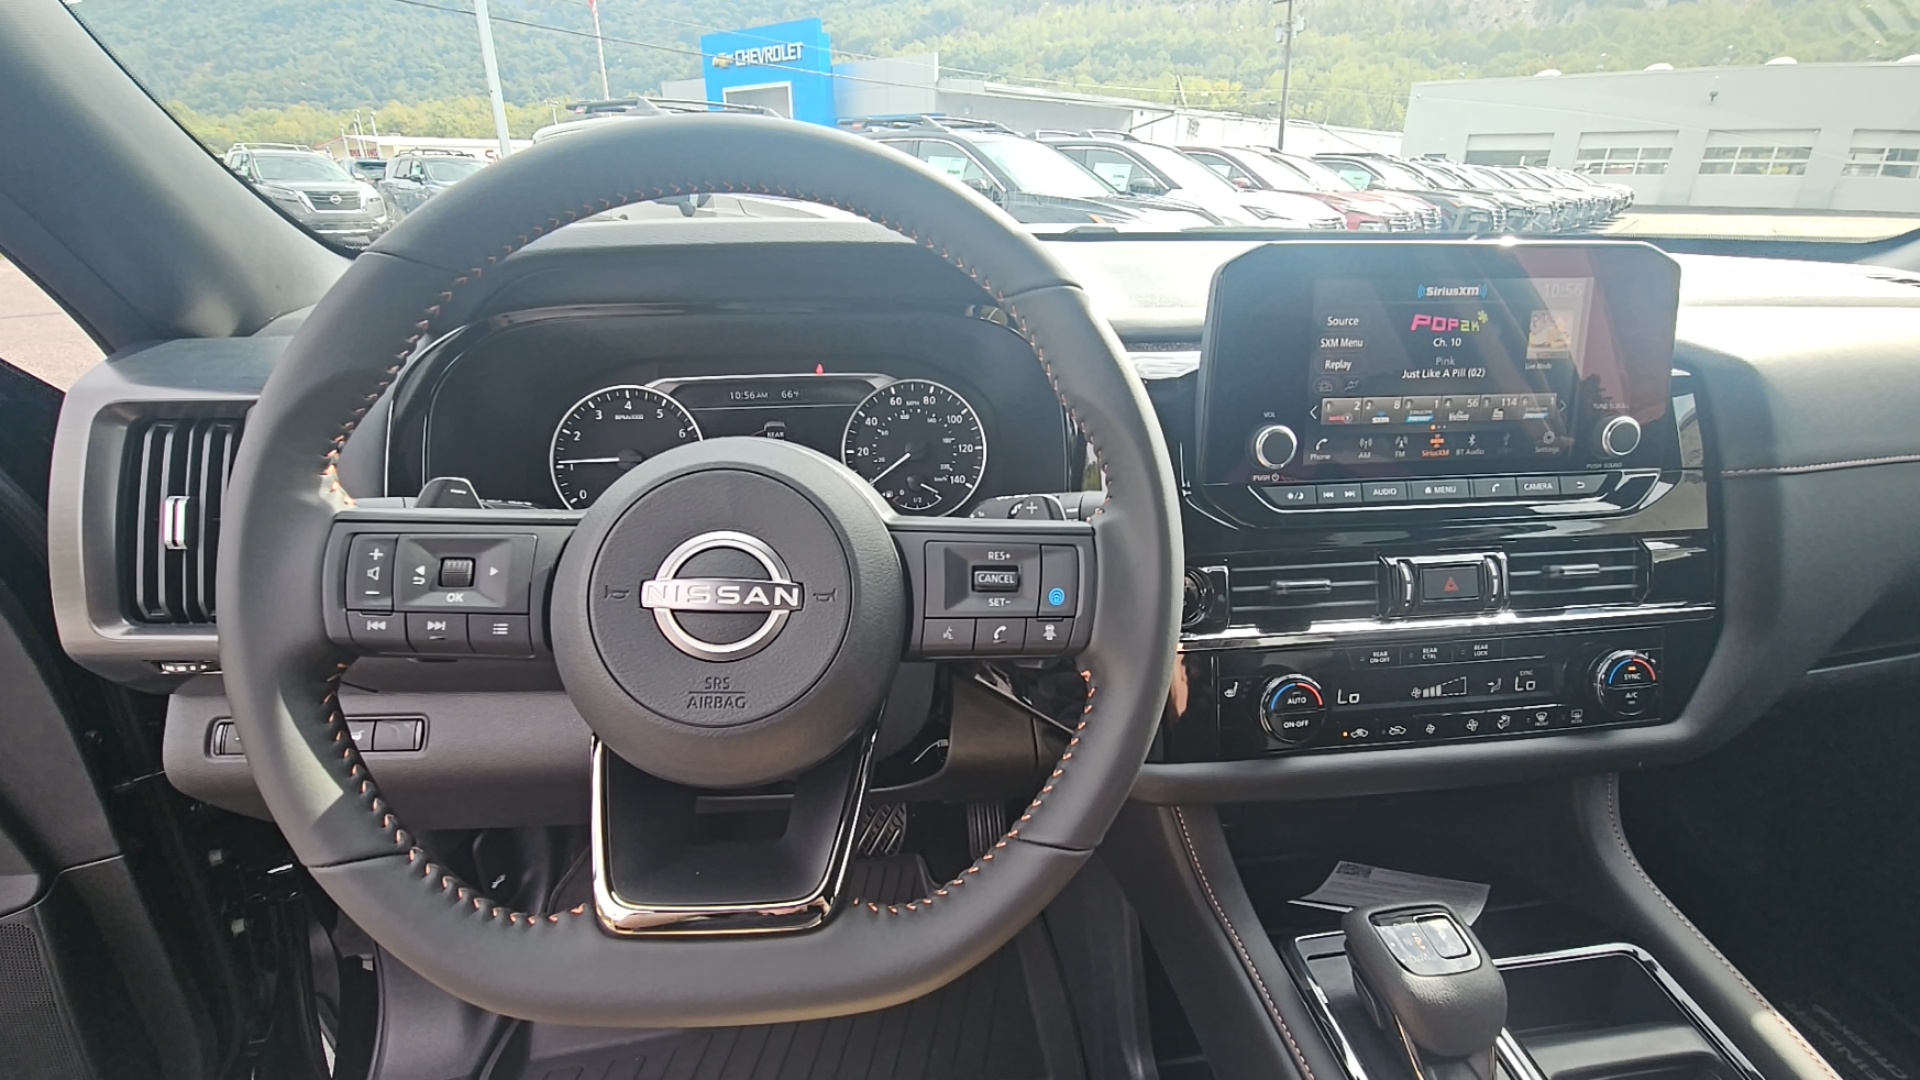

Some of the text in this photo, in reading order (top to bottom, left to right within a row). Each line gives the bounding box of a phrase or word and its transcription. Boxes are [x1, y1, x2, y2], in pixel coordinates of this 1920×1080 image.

[735, 42, 803, 66] CHEVROLET
[1544, 283, 1582, 298] 10:56
[1326, 316, 1360, 326] Source
[1320, 337, 1364, 348] SXM Menu
[1433, 338, 1462, 347] Ch. 10
[1324, 359, 1352, 371] Replay
[1435, 356, 1455, 365] Pink
[1402, 367, 1486, 379] Just Like A Pill (02)
[730, 390, 756, 400] 10:56
[923, 395, 936, 405] 80
[624, 400, 632, 410] 4
[890, 396, 903, 406] 60
[1467, 398, 1479, 408] 56
[595, 410, 603, 420] 3
[656, 409, 664, 419] 5
[946, 414, 962, 424] 100
[865, 416, 878, 426] 40
[573, 431, 581, 441] 2
[678, 428, 686, 438] 6
[857, 447, 870, 456] 20
[958, 444, 973, 453] 120
[1309, 453, 1331, 461] Phone
[1358, 451, 1371, 459] AM
[1395, 450, 1406, 458] FM
[950, 475, 966, 485] 140
[1373, 487, 1397, 496] AUDIO
[1433, 485, 1456, 494] MENU
[1523, 482, 1553, 491] CAMERA
[579, 489, 587, 499] 0
[988, 551, 1011, 561] RES+
[978, 574, 1015, 584] CANCEL
[446, 593, 463, 602] OK
[645, 585, 799, 607] NISSAN
[1624, 673, 1641, 681] SYNC
[704, 677, 730, 690] SRS
[1514, 676, 1536, 691] Lo
[1287, 696, 1307, 704] AUTO
[1337, 688, 1360, 704] Lo
[686, 696, 746, 709] AIRBAG
